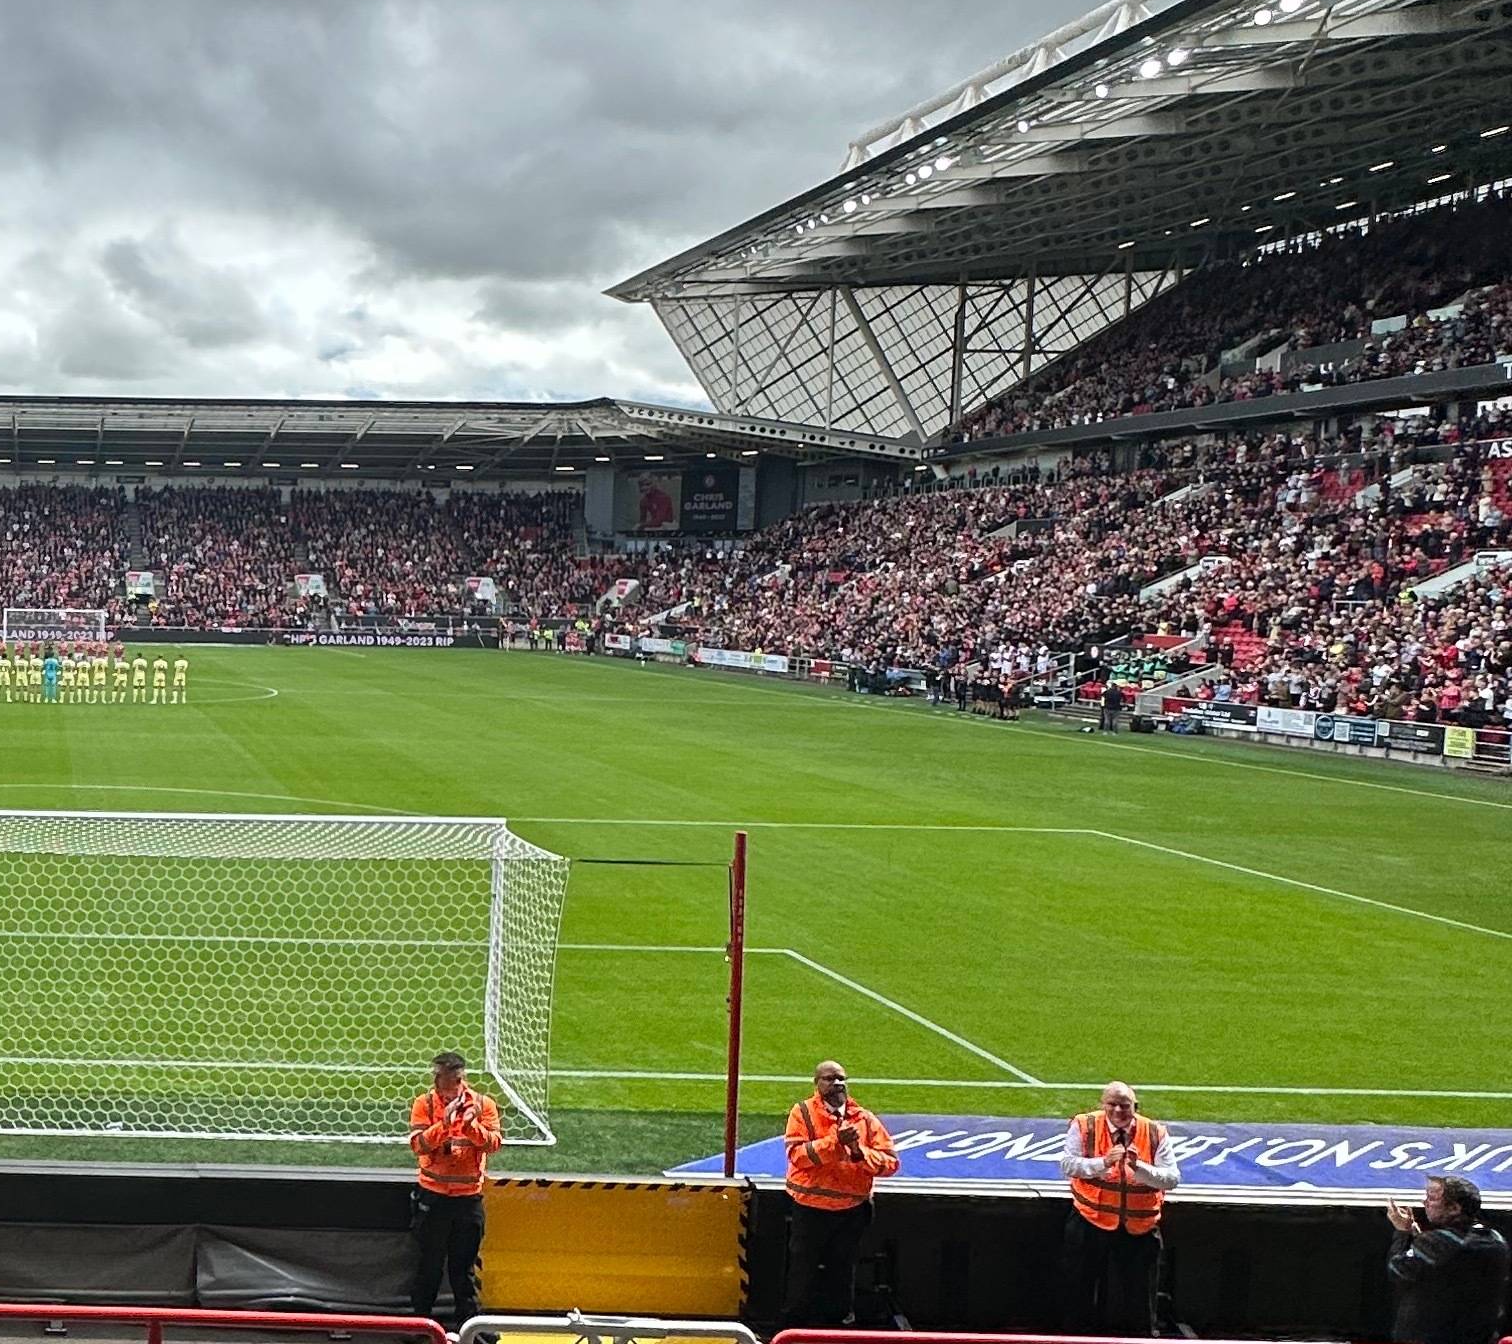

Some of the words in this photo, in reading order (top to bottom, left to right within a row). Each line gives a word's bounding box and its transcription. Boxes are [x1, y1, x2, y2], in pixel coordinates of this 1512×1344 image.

[684, 501, 733, 511] GARLAND
[319, 635, 374, 646] GARLAND
[376, 636, 433, 646] 1949-2023
[436, 636, 454, 647] RIP
